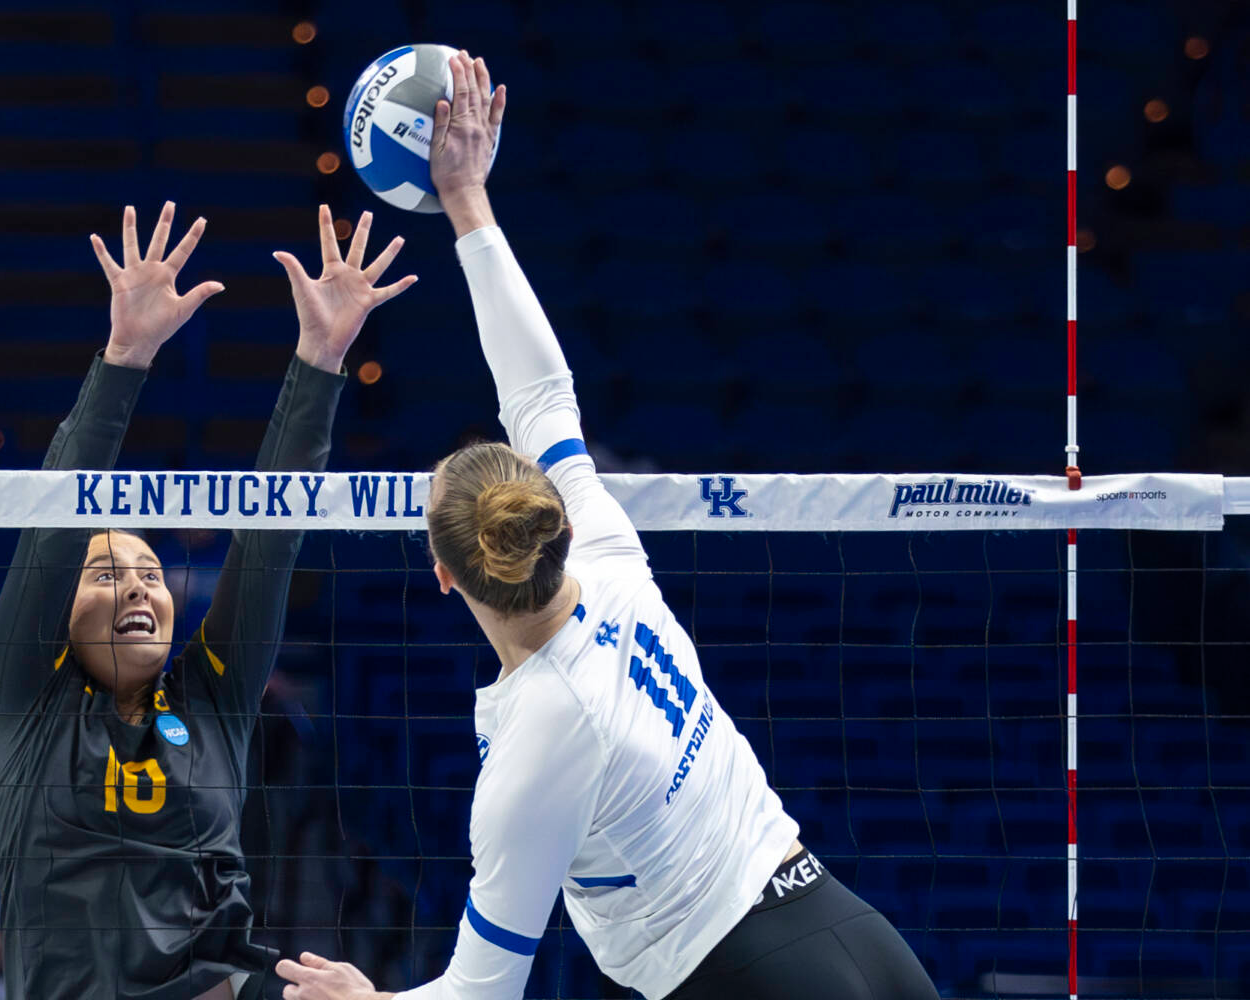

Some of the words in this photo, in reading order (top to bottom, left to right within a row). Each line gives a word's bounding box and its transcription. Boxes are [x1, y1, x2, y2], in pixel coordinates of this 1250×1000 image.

[352, 65, 398, 148] molten
[75, 473, 325, 518] KENTUCKY
[349, 475, 433, 518] WIL
[699, 476, 749, 518] UK
[888, 477, 956, 518] paul
[954, 479, 1034, 506] miller
[905, 510, 950, 518] MOTOR
[956, 510, 1018, 518] COMPANY
[1096, 491, 1128, 502] sports
[1129, 490, 1167, 500] imports
[629, 621, 698, 739] 11
[104, 744, 167, 814] 10
